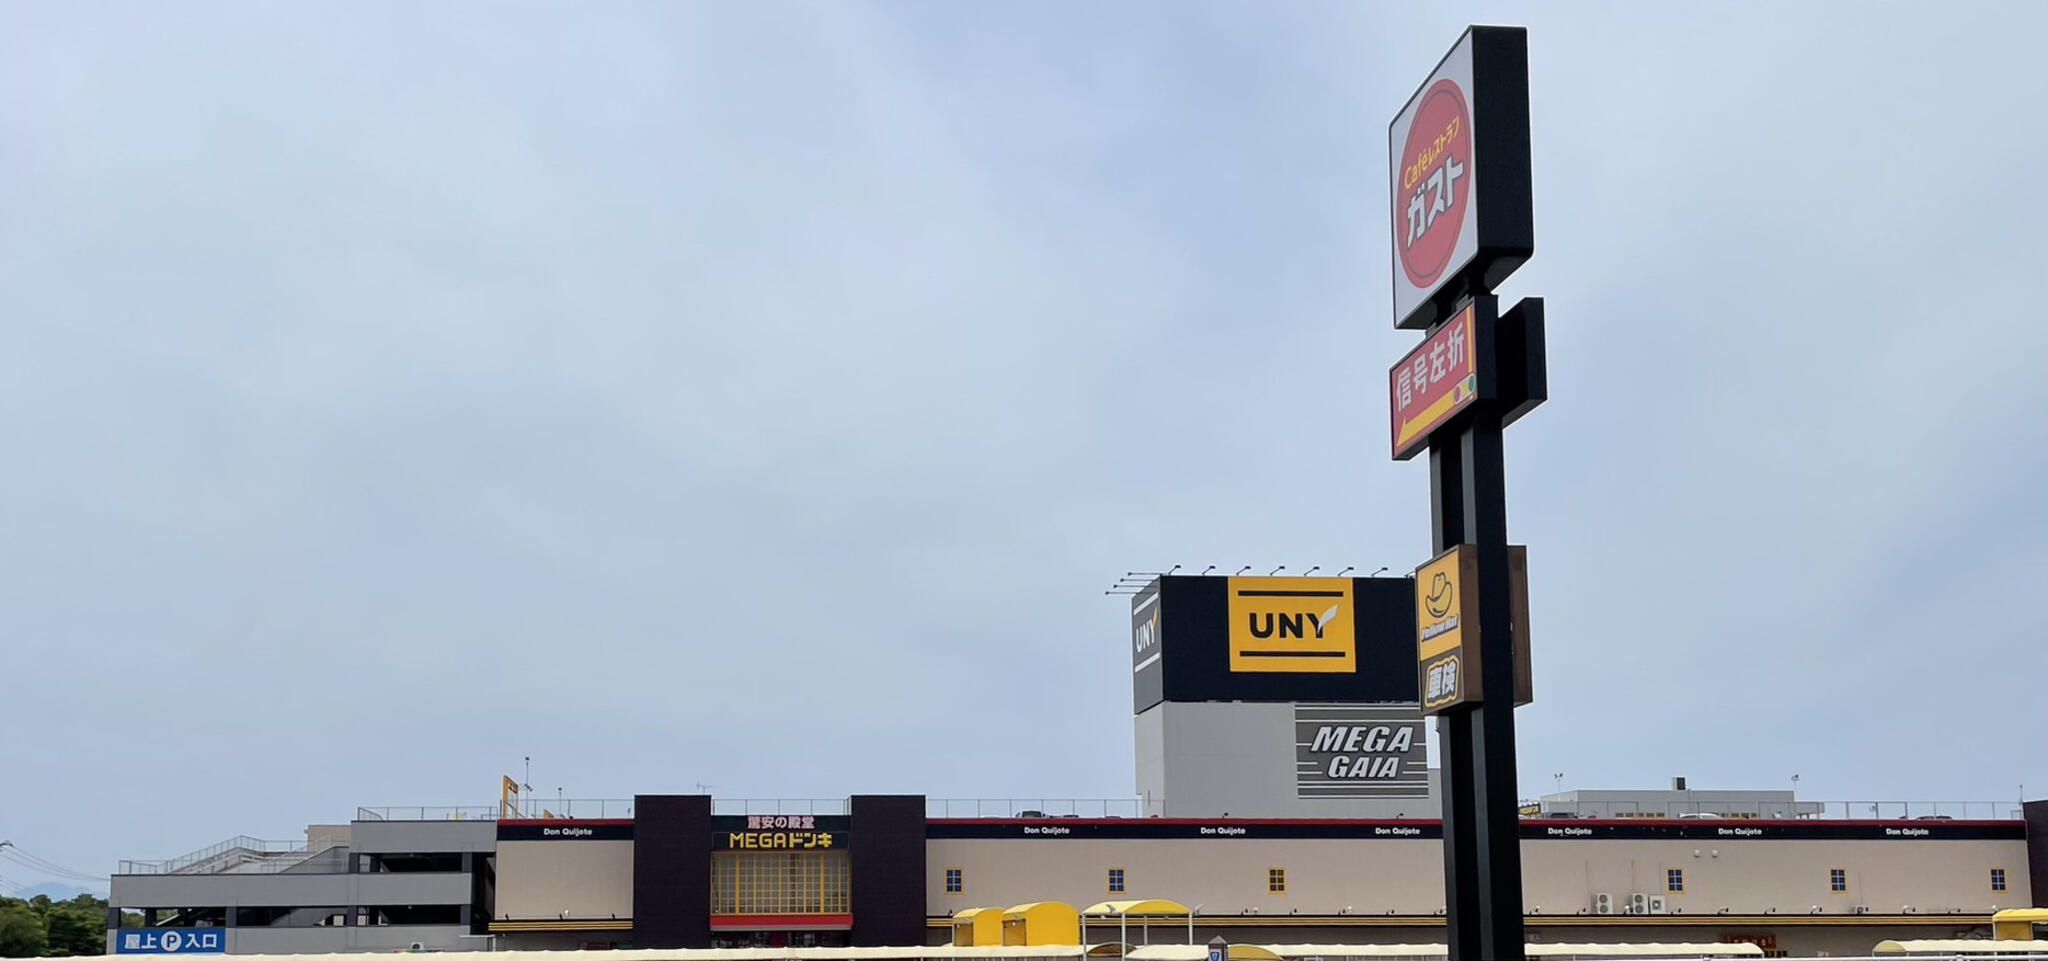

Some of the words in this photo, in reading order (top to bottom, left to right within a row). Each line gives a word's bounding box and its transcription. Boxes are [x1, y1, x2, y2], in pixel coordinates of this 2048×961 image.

[1406, 155, 1464, 249] ガスト
[1396, 322, 1465, 412] 信号左折
[1249, 604, 1338, 639] UNY
[1135, 608, 1158, 653] UNY
[1310, 726, 1414, 753] MEGA
[1327, 755, 1399, 778] GAIA
[747, 815, 815, 830] 驚安の殿堂
[543, 828, 560, 836] Don
[562, 828, 593, 837] Quijote
[1024, 827, 1040, 835] Don
[1041, 827, 1070, 836] Quijote
[1200, 827, 1216, 835] Don
[1217, 827, 1246, 836] Quijote
[1375, 827, 1391, 835] Don
[1392, 827, 1421, 836] Quijote
[1547, 827, 1564, 835] Don
[1564, 827, 1593, 836] Quijote
[1718, 828, 1734, 836] Don
[1734, 828, 1763, 837] Quijote
[1886, 828, 1901, 836] Don
[1902, 828, 1929, 837] Quijote
